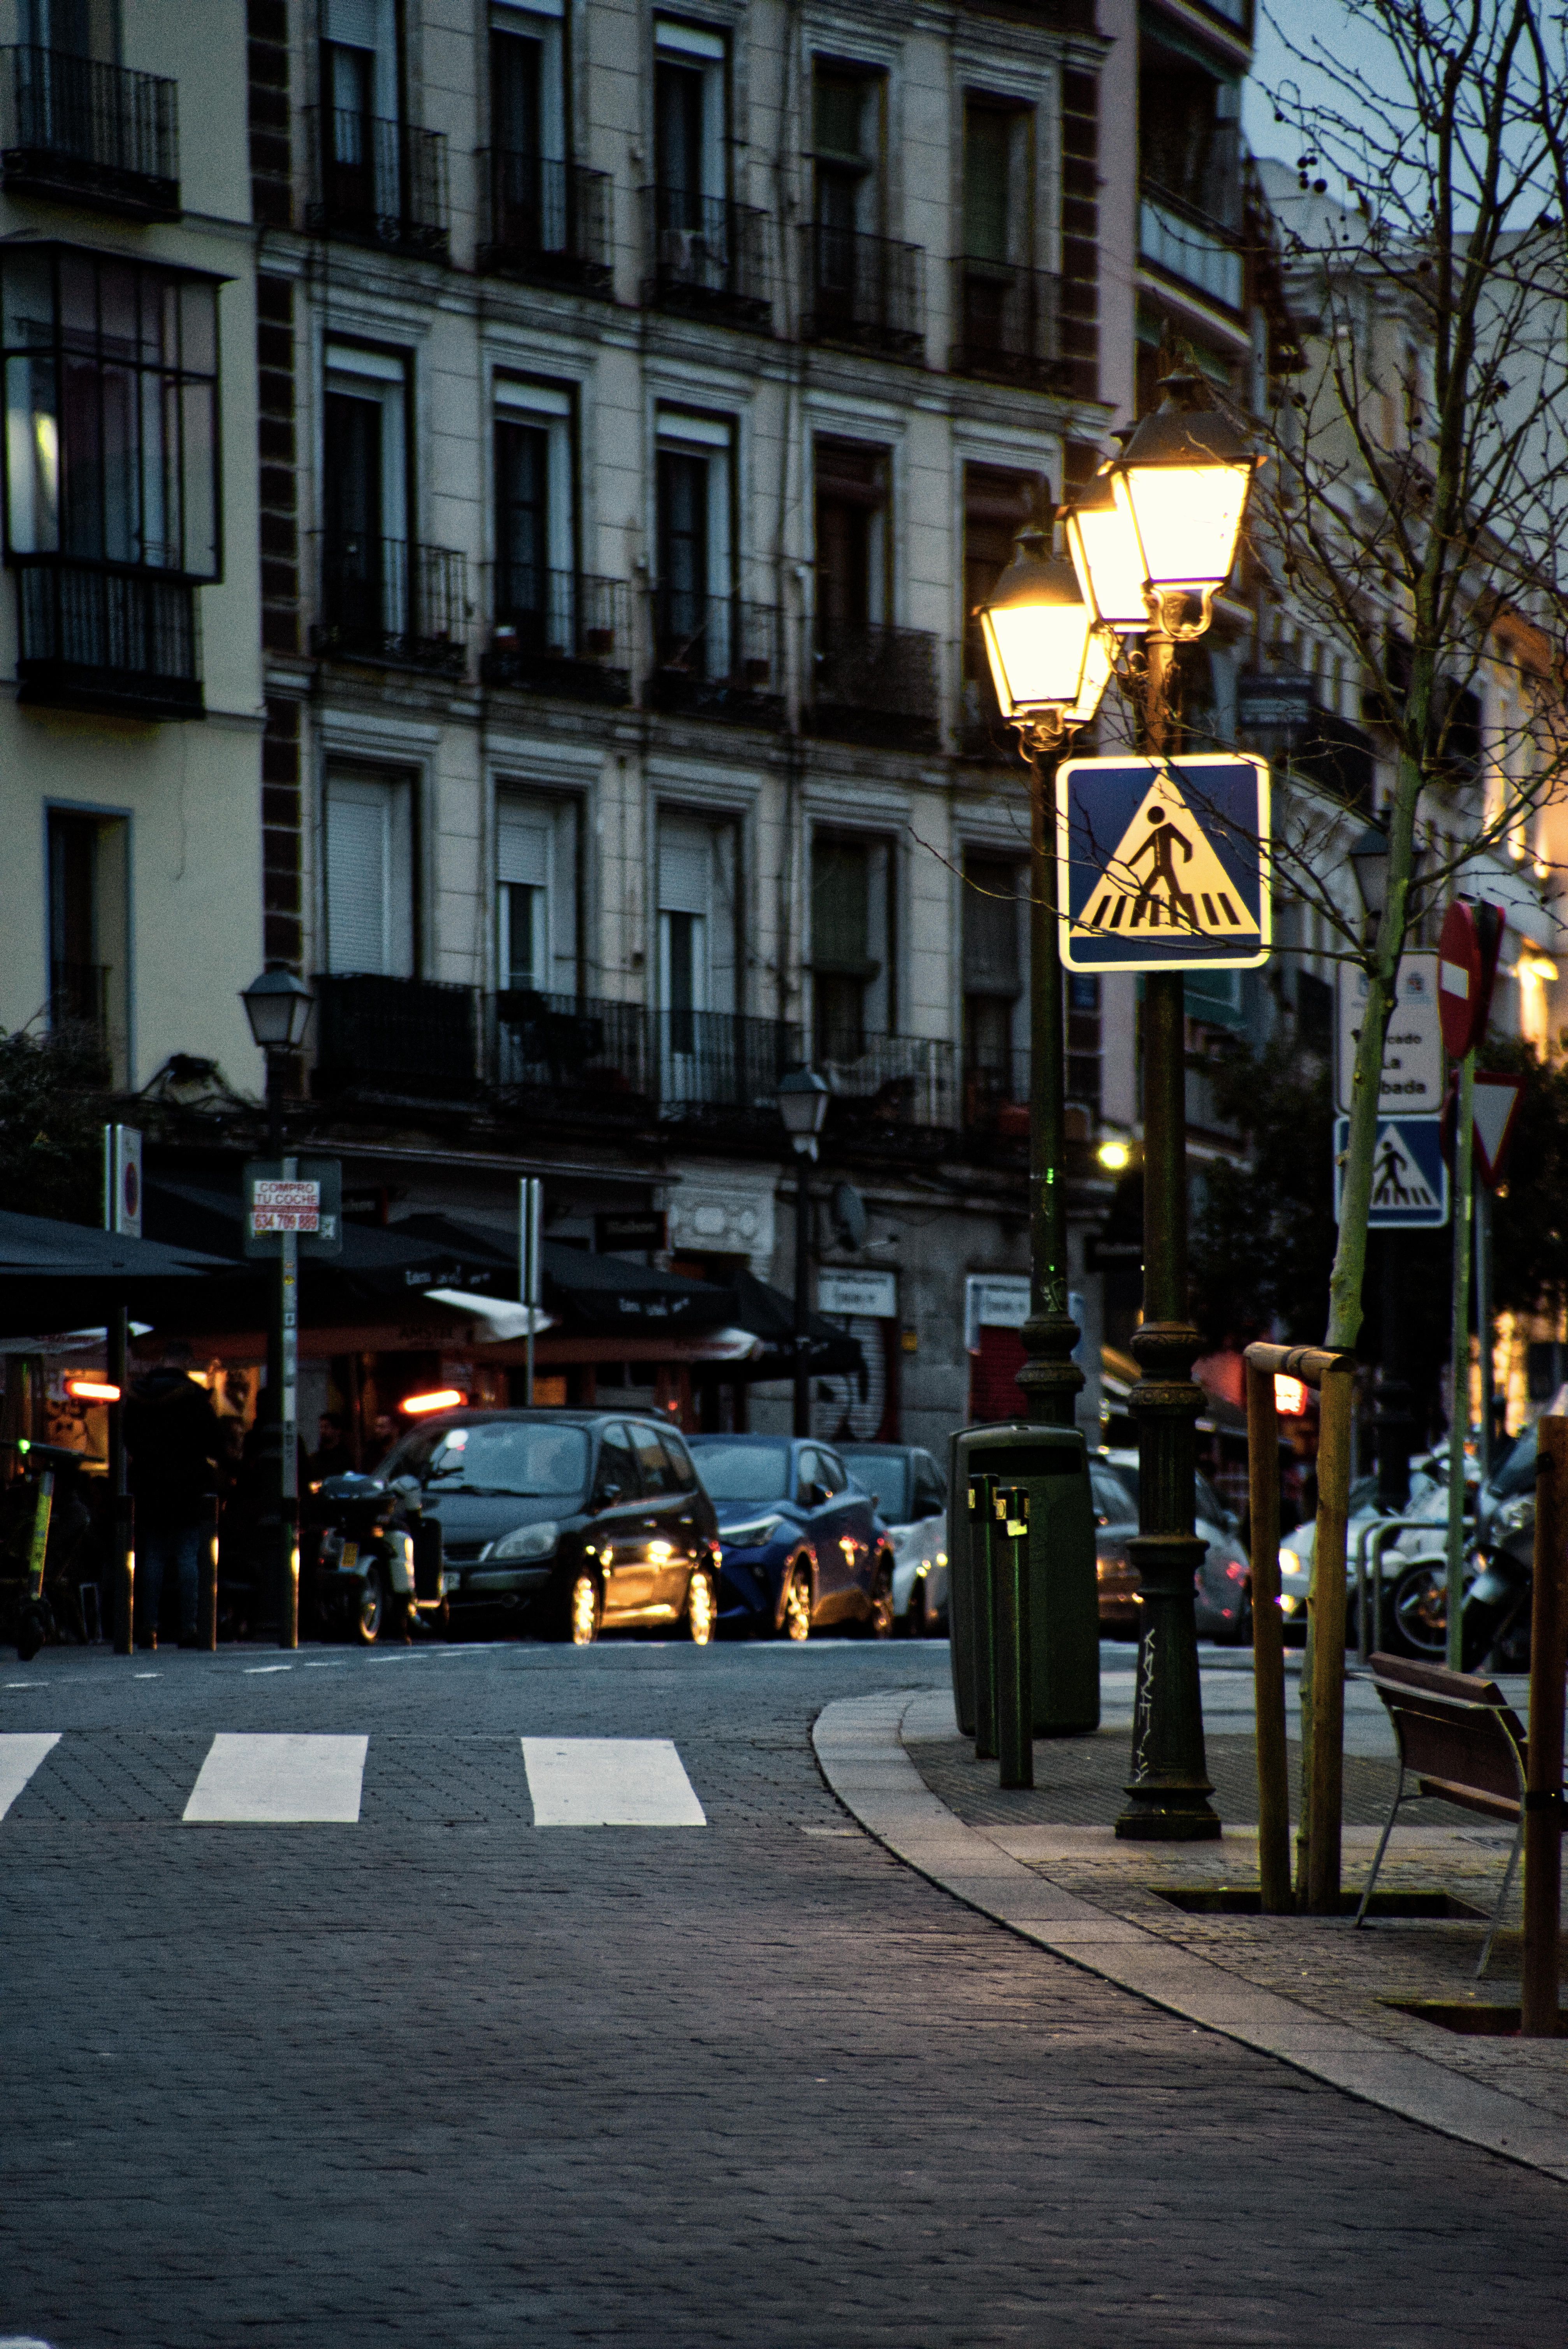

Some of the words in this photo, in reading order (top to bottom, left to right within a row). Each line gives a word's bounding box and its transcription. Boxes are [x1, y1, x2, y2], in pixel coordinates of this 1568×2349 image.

[1387, 1033, 1422, 1044] cado
[1380, 1080, 1426, 1094] bada
[260, 1182, 314, 1194] COMPRO
[256, 1194, 271, 1204] TU
[276, 1194, 317, 1204] COCHE
[255, 1213, 274, 1229] 634
